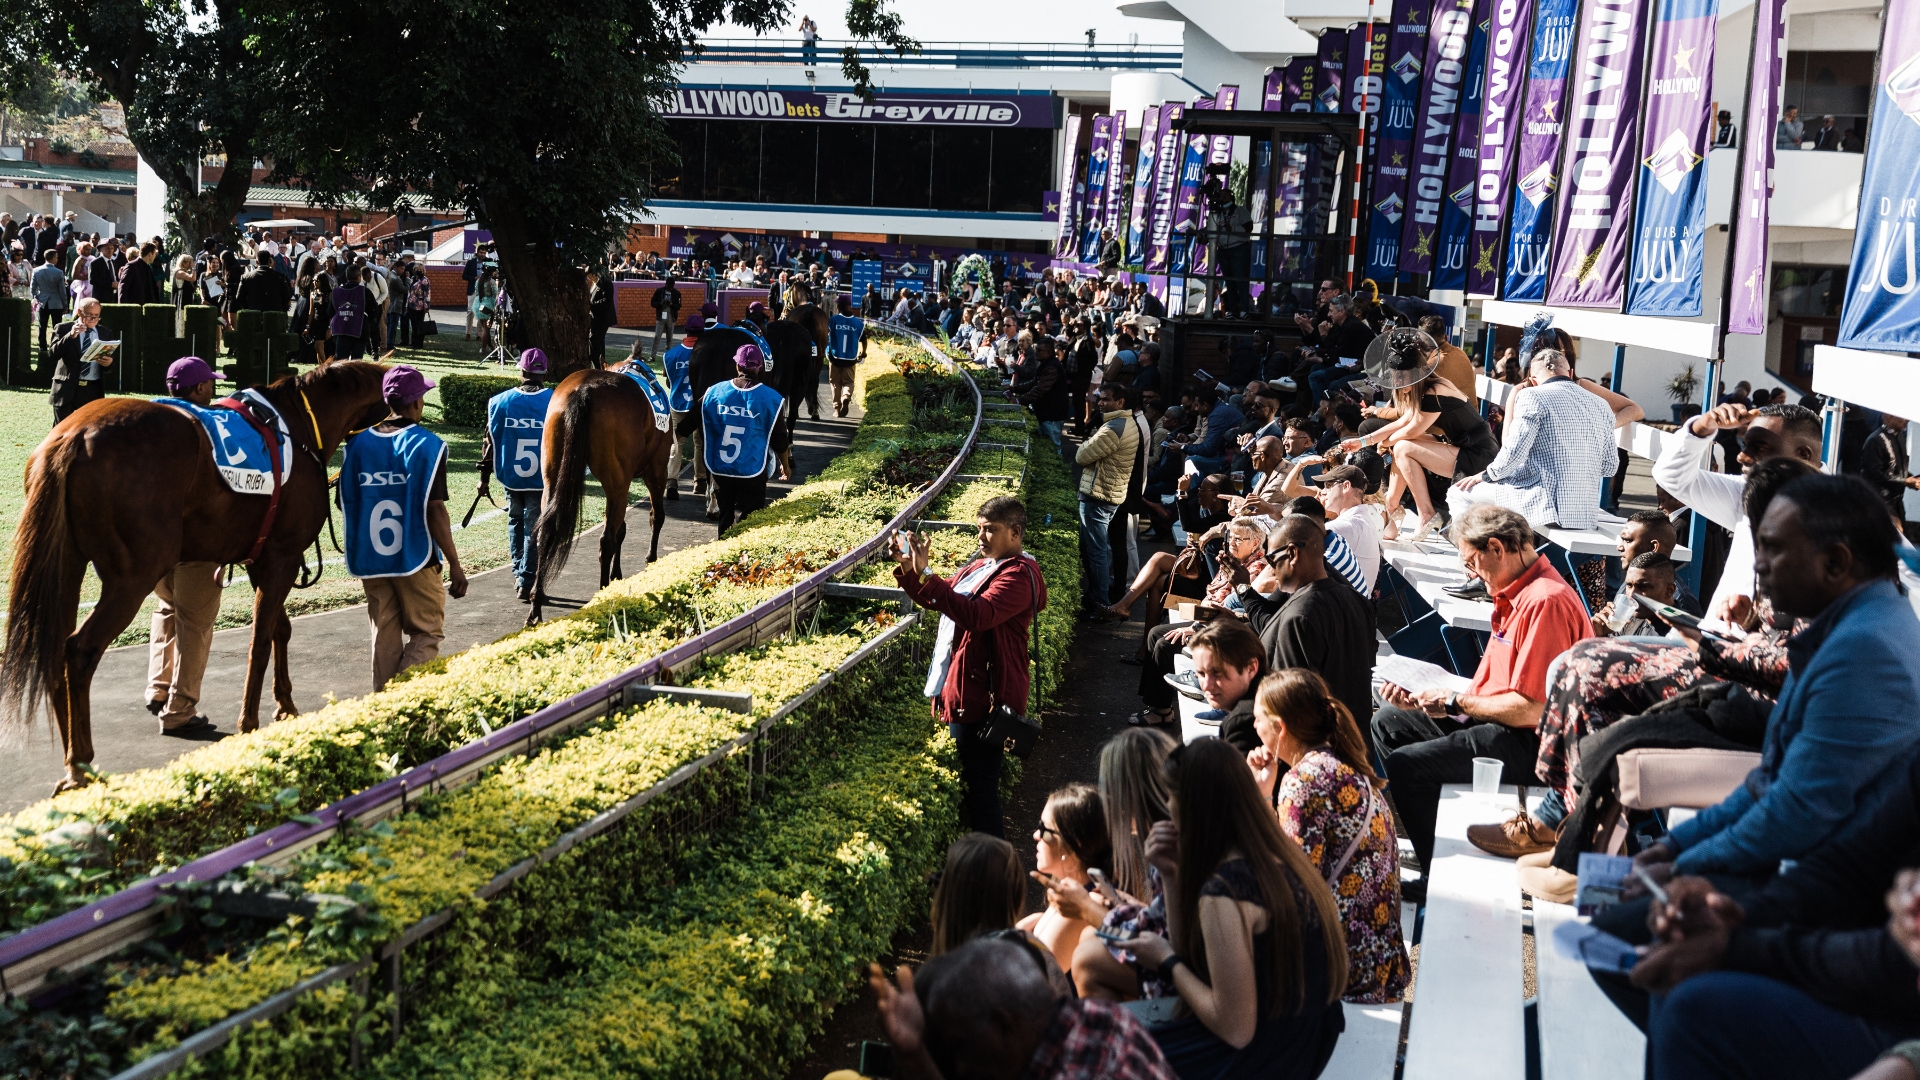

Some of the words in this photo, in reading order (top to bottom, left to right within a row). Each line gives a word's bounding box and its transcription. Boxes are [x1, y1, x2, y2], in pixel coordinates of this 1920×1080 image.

[1298, 65, 1313, 100] bets
[786, 101, 821, 117] bets
[824, 93, 1013, 122] Greyville
[1414, 10, 1470, 225] HOLLYWOOD
[1568, 0, 1634, 229] HOLLYW
[1636, 238, 1692, 284] JULY
[513, 438, 539, 478] 5
[719, 424, 746, 464] 5
[369, 499, 404, 556] 6
